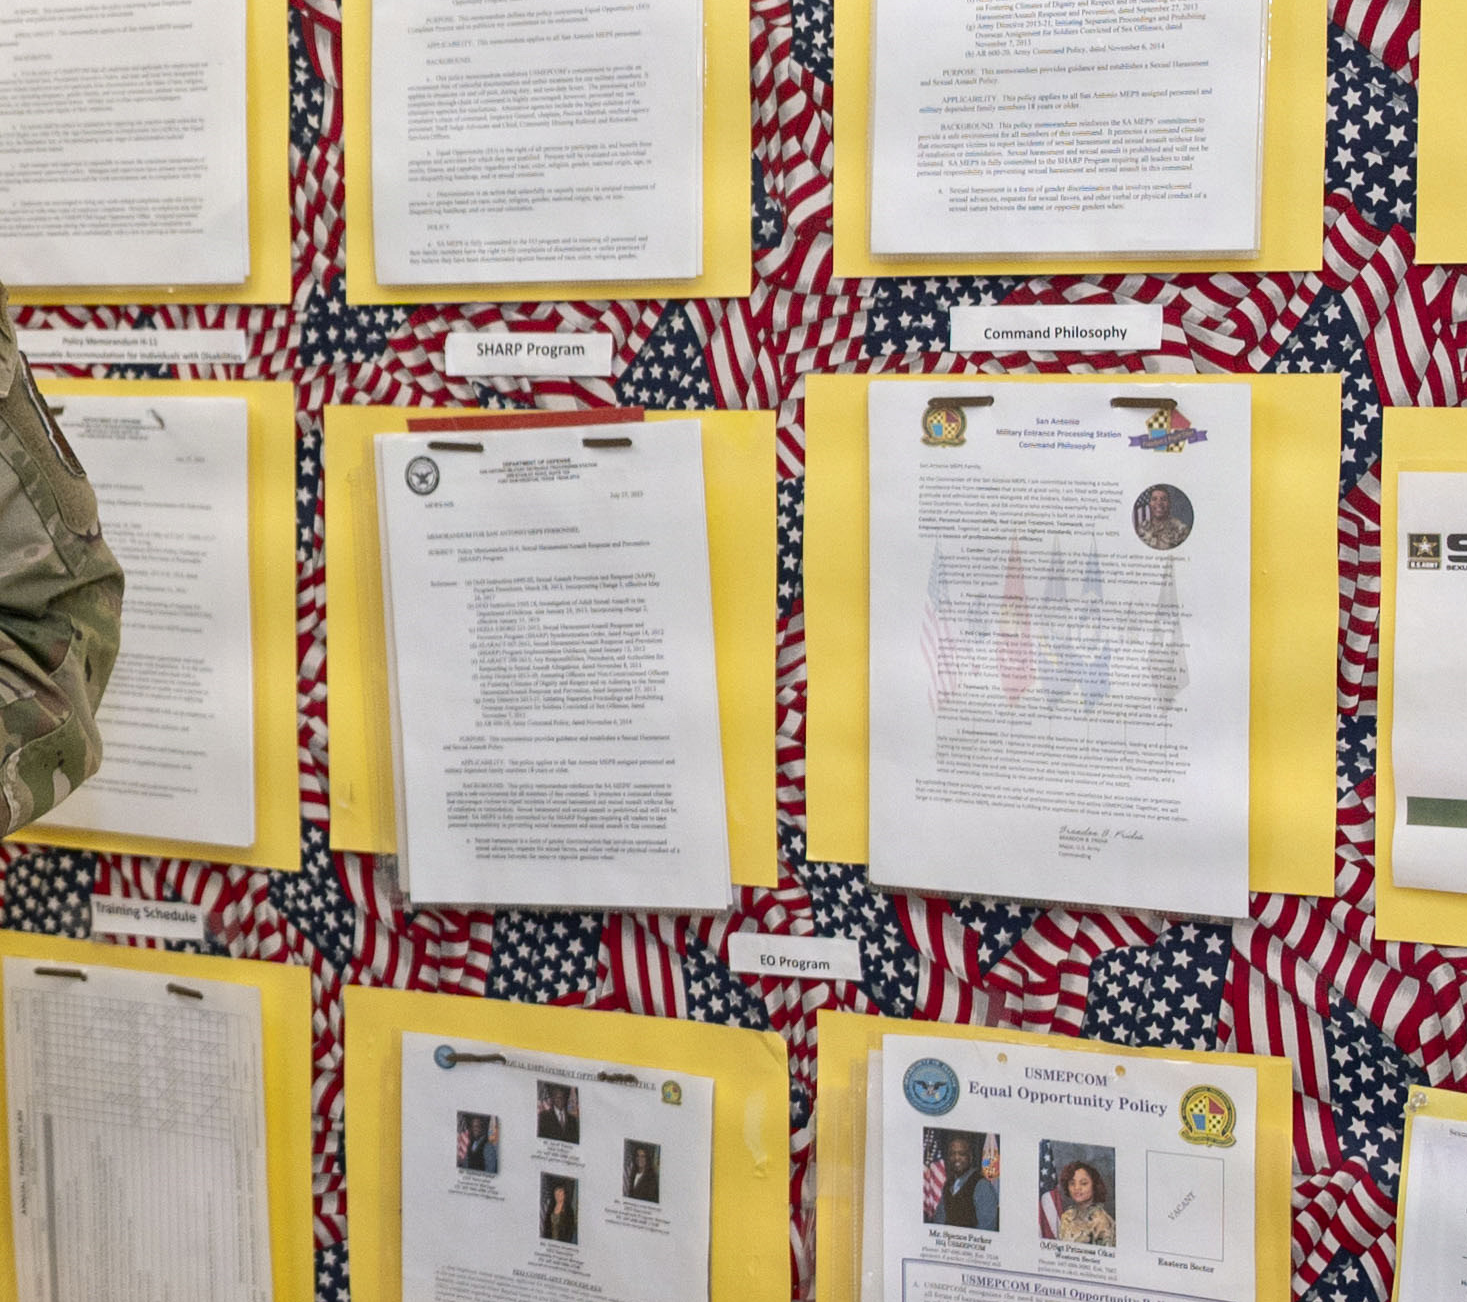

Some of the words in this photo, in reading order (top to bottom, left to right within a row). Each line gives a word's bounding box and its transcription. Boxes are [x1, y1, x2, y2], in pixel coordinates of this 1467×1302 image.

[983, 324, 1051, 341] Command
[1054, 323, 1128, 343] Philosophy
[476, 342, 523, 357] SHARP
[527, 343, 585, 359] Program
[96, 901, 140, 920] Training
[143, 905, 198, 923] Schedule
[760, 954, 776, 966] EO
[779, 956, 830, 971] Program
[1023, 1067, 1108, 1087] USMEPCOM
[967, 1081, 1013, 1100] Equal
[1016, 1086, 1114, 1111] Opportunity
[1117, 1095, 1168, 1117] Policy
[1167, 1191, 1196, 1222] VACANT
